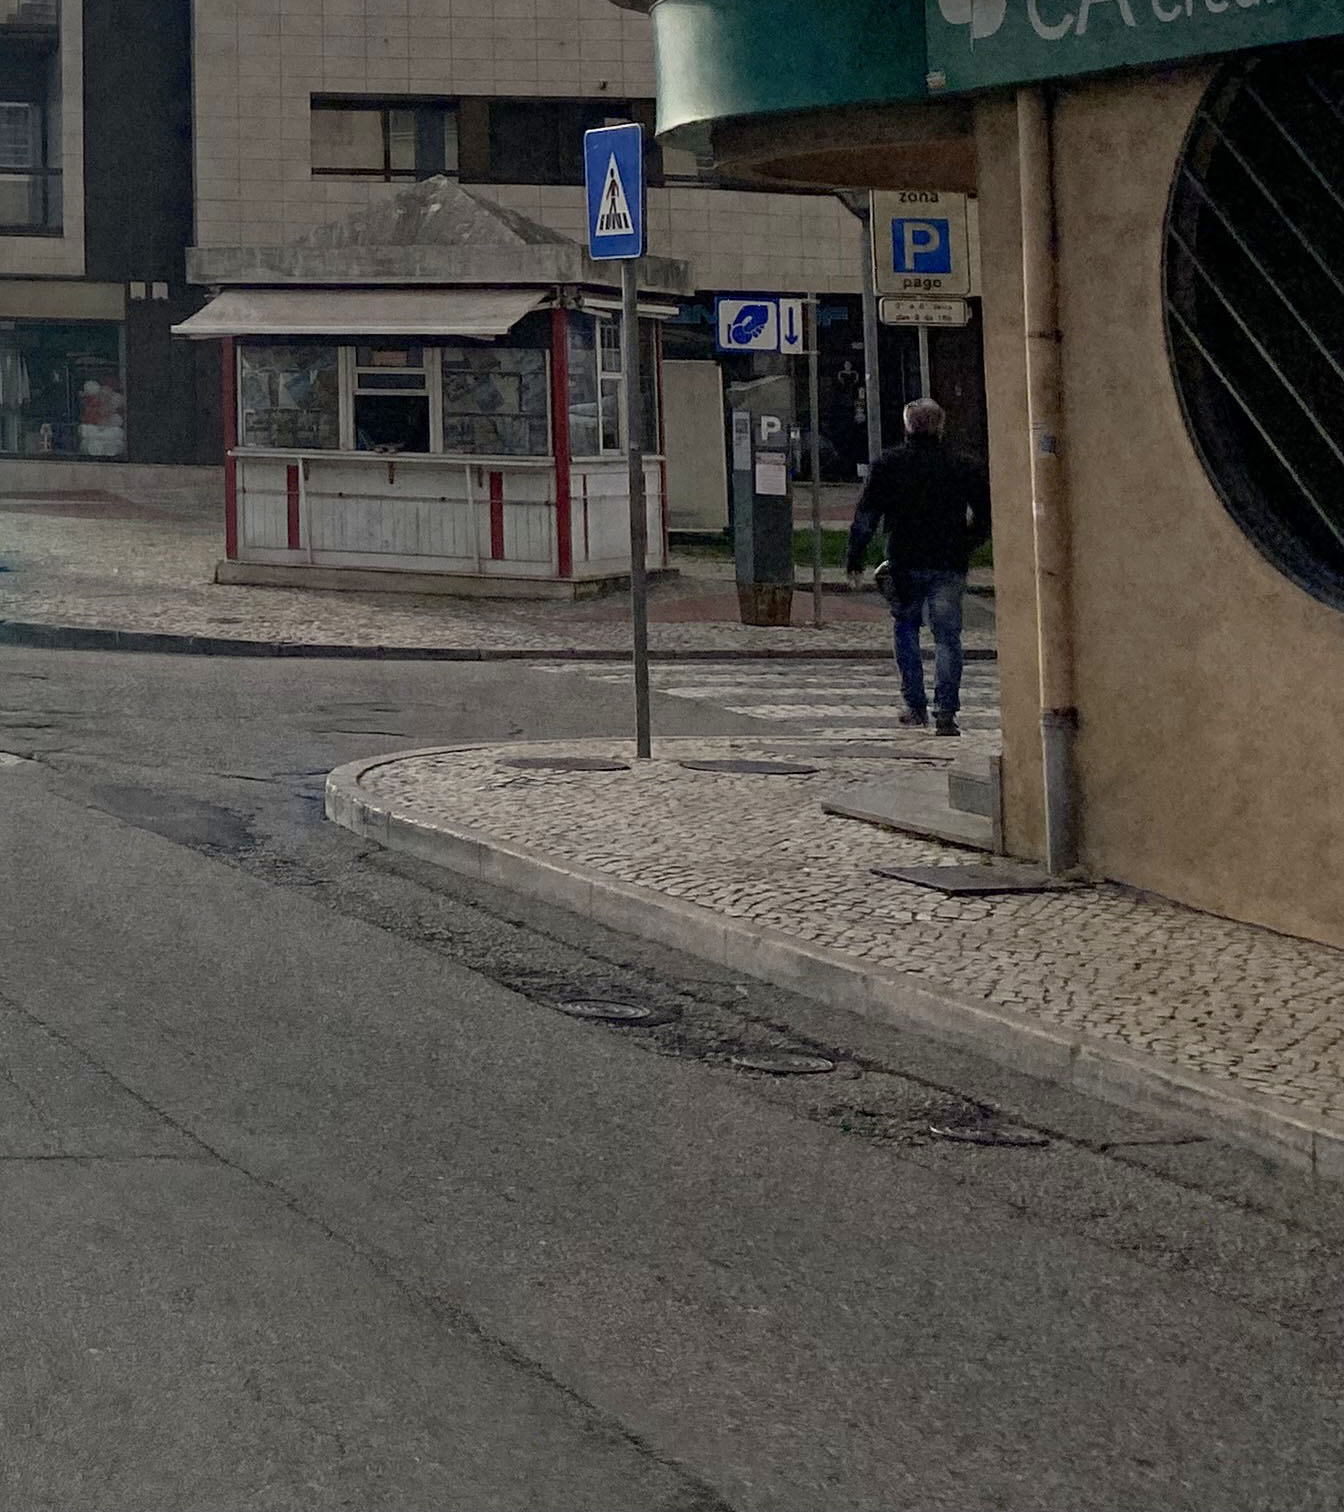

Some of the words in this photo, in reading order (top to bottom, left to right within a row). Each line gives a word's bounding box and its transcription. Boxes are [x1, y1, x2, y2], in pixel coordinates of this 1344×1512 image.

[898, 190, 940, 203] zona
[903, 222, 940, 269] P
[903, 278, 942, 290] pago
[761, 415, 782, 441] P
